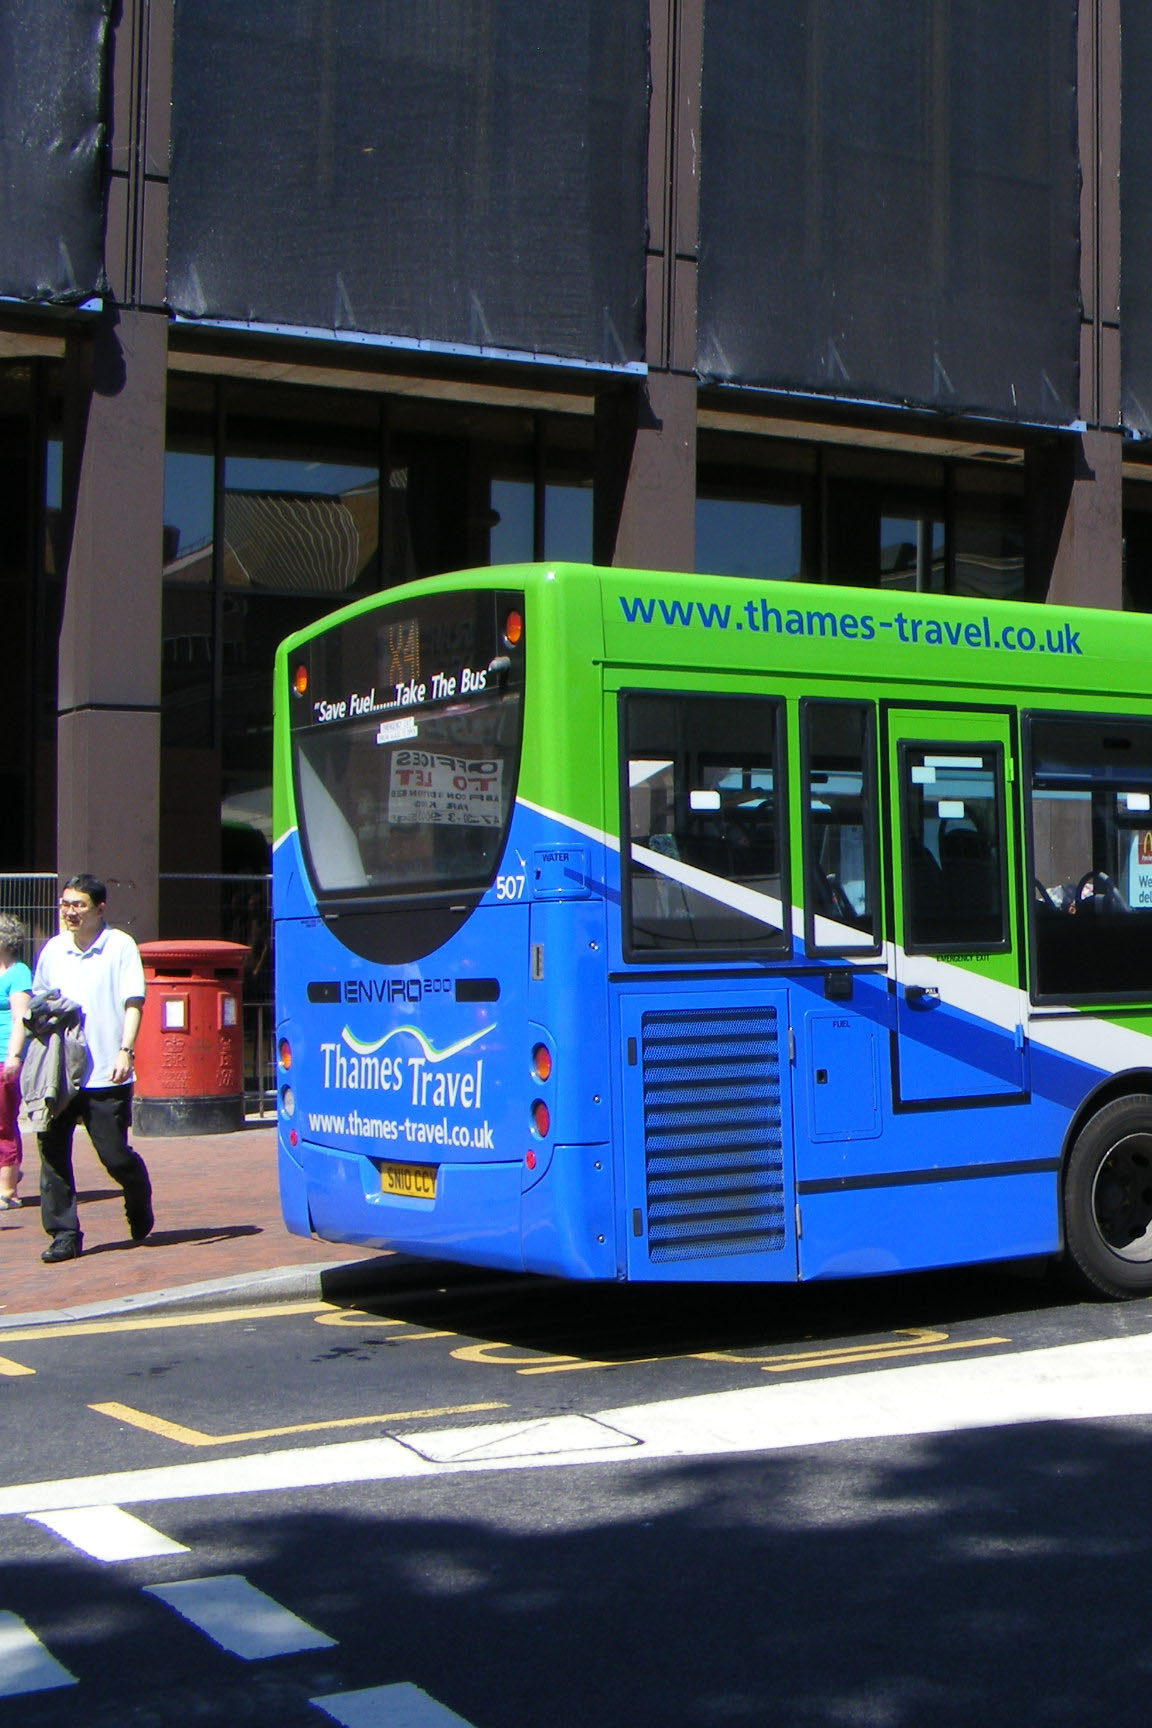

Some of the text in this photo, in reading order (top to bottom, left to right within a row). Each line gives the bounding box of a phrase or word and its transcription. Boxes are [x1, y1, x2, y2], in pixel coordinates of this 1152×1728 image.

[618, 596, 1083, 655] www.thames-travel.co.uk
[431, 672, 457, 700] The
[543, 853, 569, 862] WATER
[496, 876, 526, 900] 507
[832, 1020, 850, 1028] FUEL
[320, 1043, 483, 1108] Thames Travel
[308, 1110, 494, 1149] www.thames-travel.co.uk
[387, 1166, 412, 1190] SN10
